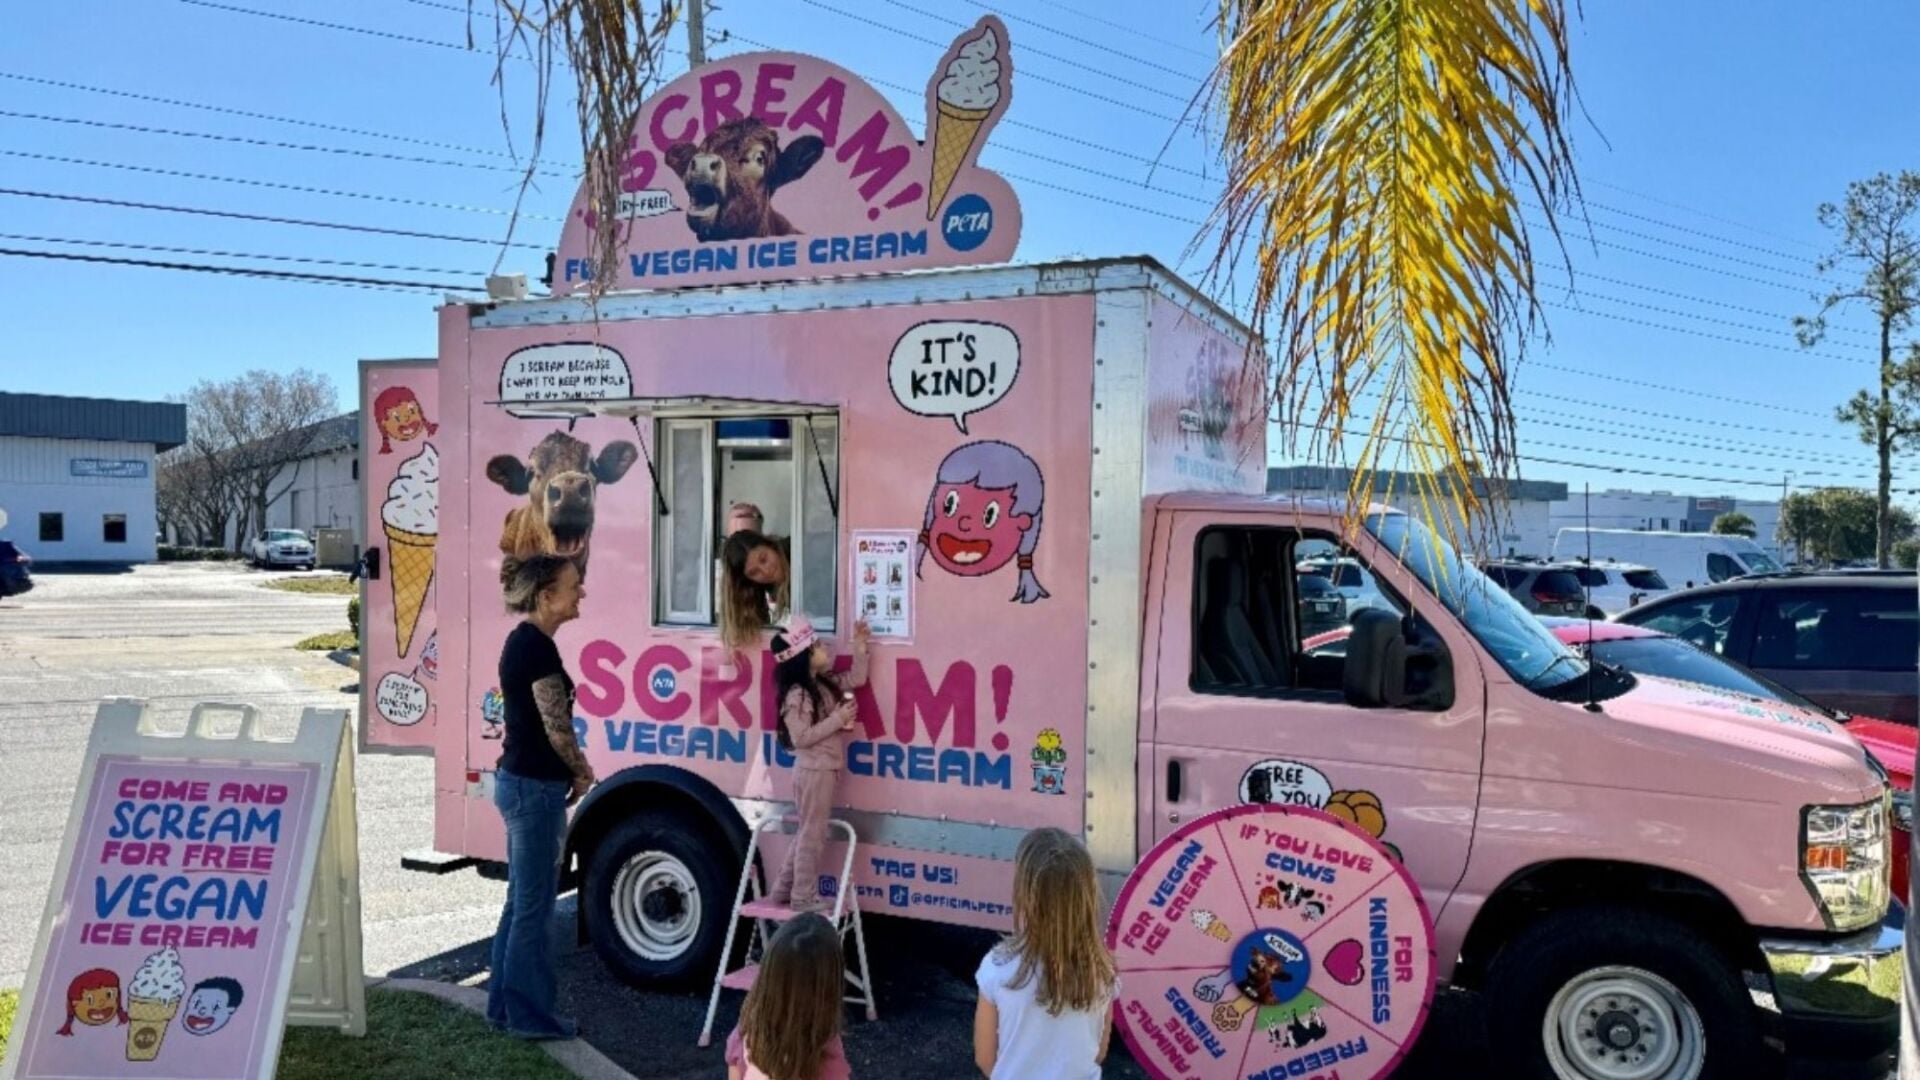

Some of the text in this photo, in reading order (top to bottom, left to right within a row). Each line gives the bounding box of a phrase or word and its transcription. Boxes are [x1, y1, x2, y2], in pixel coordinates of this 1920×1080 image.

[629, 246, 737, 277] VEGAN
[749, 241, 798, 271] ICE
[808, 229, 928, 263] CREAM
[527, 361, 565, 373] SCREAM
[568, 360, 611, 372] BECAUSE
[921, 331, 976, 364] IT'S
[911, 361, 996, 399] KIND!
[576, 639, 1014, 751] SCRAM!
[604, 719, 746, 764] VEGAN
[847, 740, 1012, 790] CREAM
[1264, 766, 1303, 785] FREE
[118, 778, 288, 805] COME AND
[1281, 790, 1320, 809] YOU
[108, 801, 281, 844] SCREAM
[100, 840, 275, 870] FOR FREE
[1240, 823, 1373, 874] IF YOU LOVE
[1265, 852, 1337, 884] COWS
[871, 857, 958, 885] TAG US!
[95, 874, 268, 921] VEGAN
[1121, 839, 1203, 949] FOR VEGAN
[1142, 854, 1218, 956] ICE CREAM
[80, 922, 259, 949] ICE CREAM
[1369, 897, 1391, 1024] KINDNESS
[1394, 936, 1414, 983] FOR
[1126, 1000, 1191, 1075] ANIMALS
[1164, 986, 1226, 1060] FRIENDS
[1164, 1017, 1199, 1055] ARE
